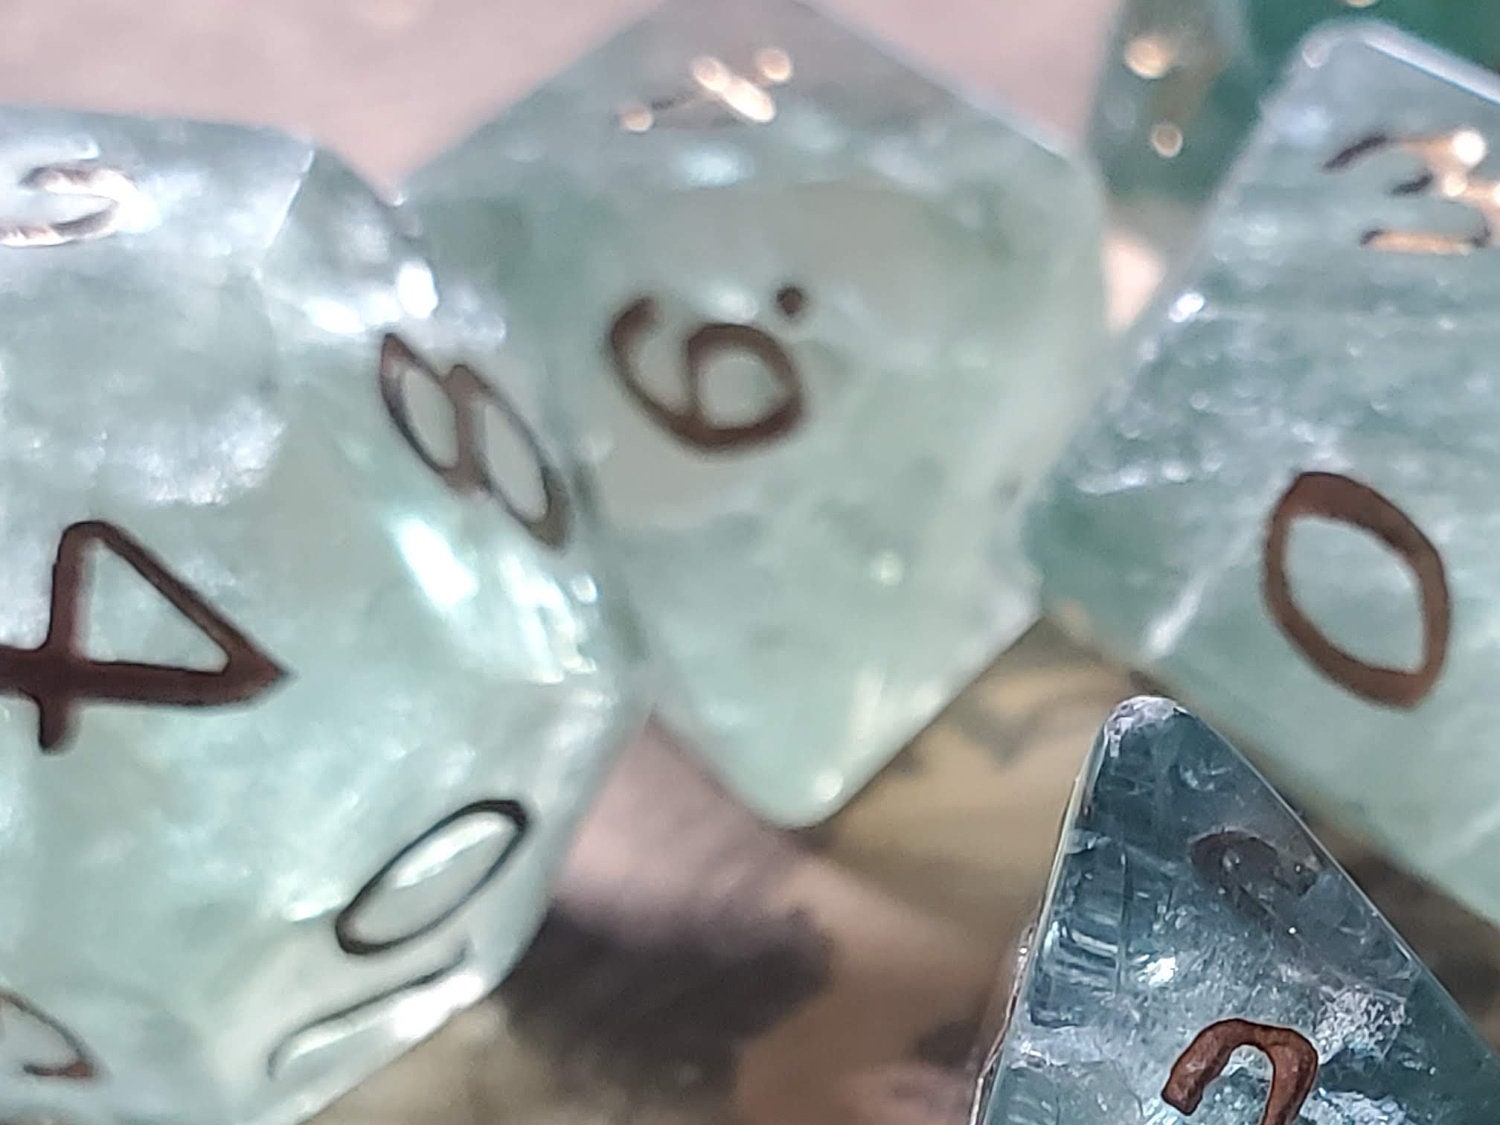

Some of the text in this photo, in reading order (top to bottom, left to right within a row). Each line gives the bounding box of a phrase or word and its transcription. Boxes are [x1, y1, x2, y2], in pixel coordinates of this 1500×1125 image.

[378, 332, 572, 552] 8
[0, 520, 288, 755] 4
[1262, 470, 1452, 708] 0
